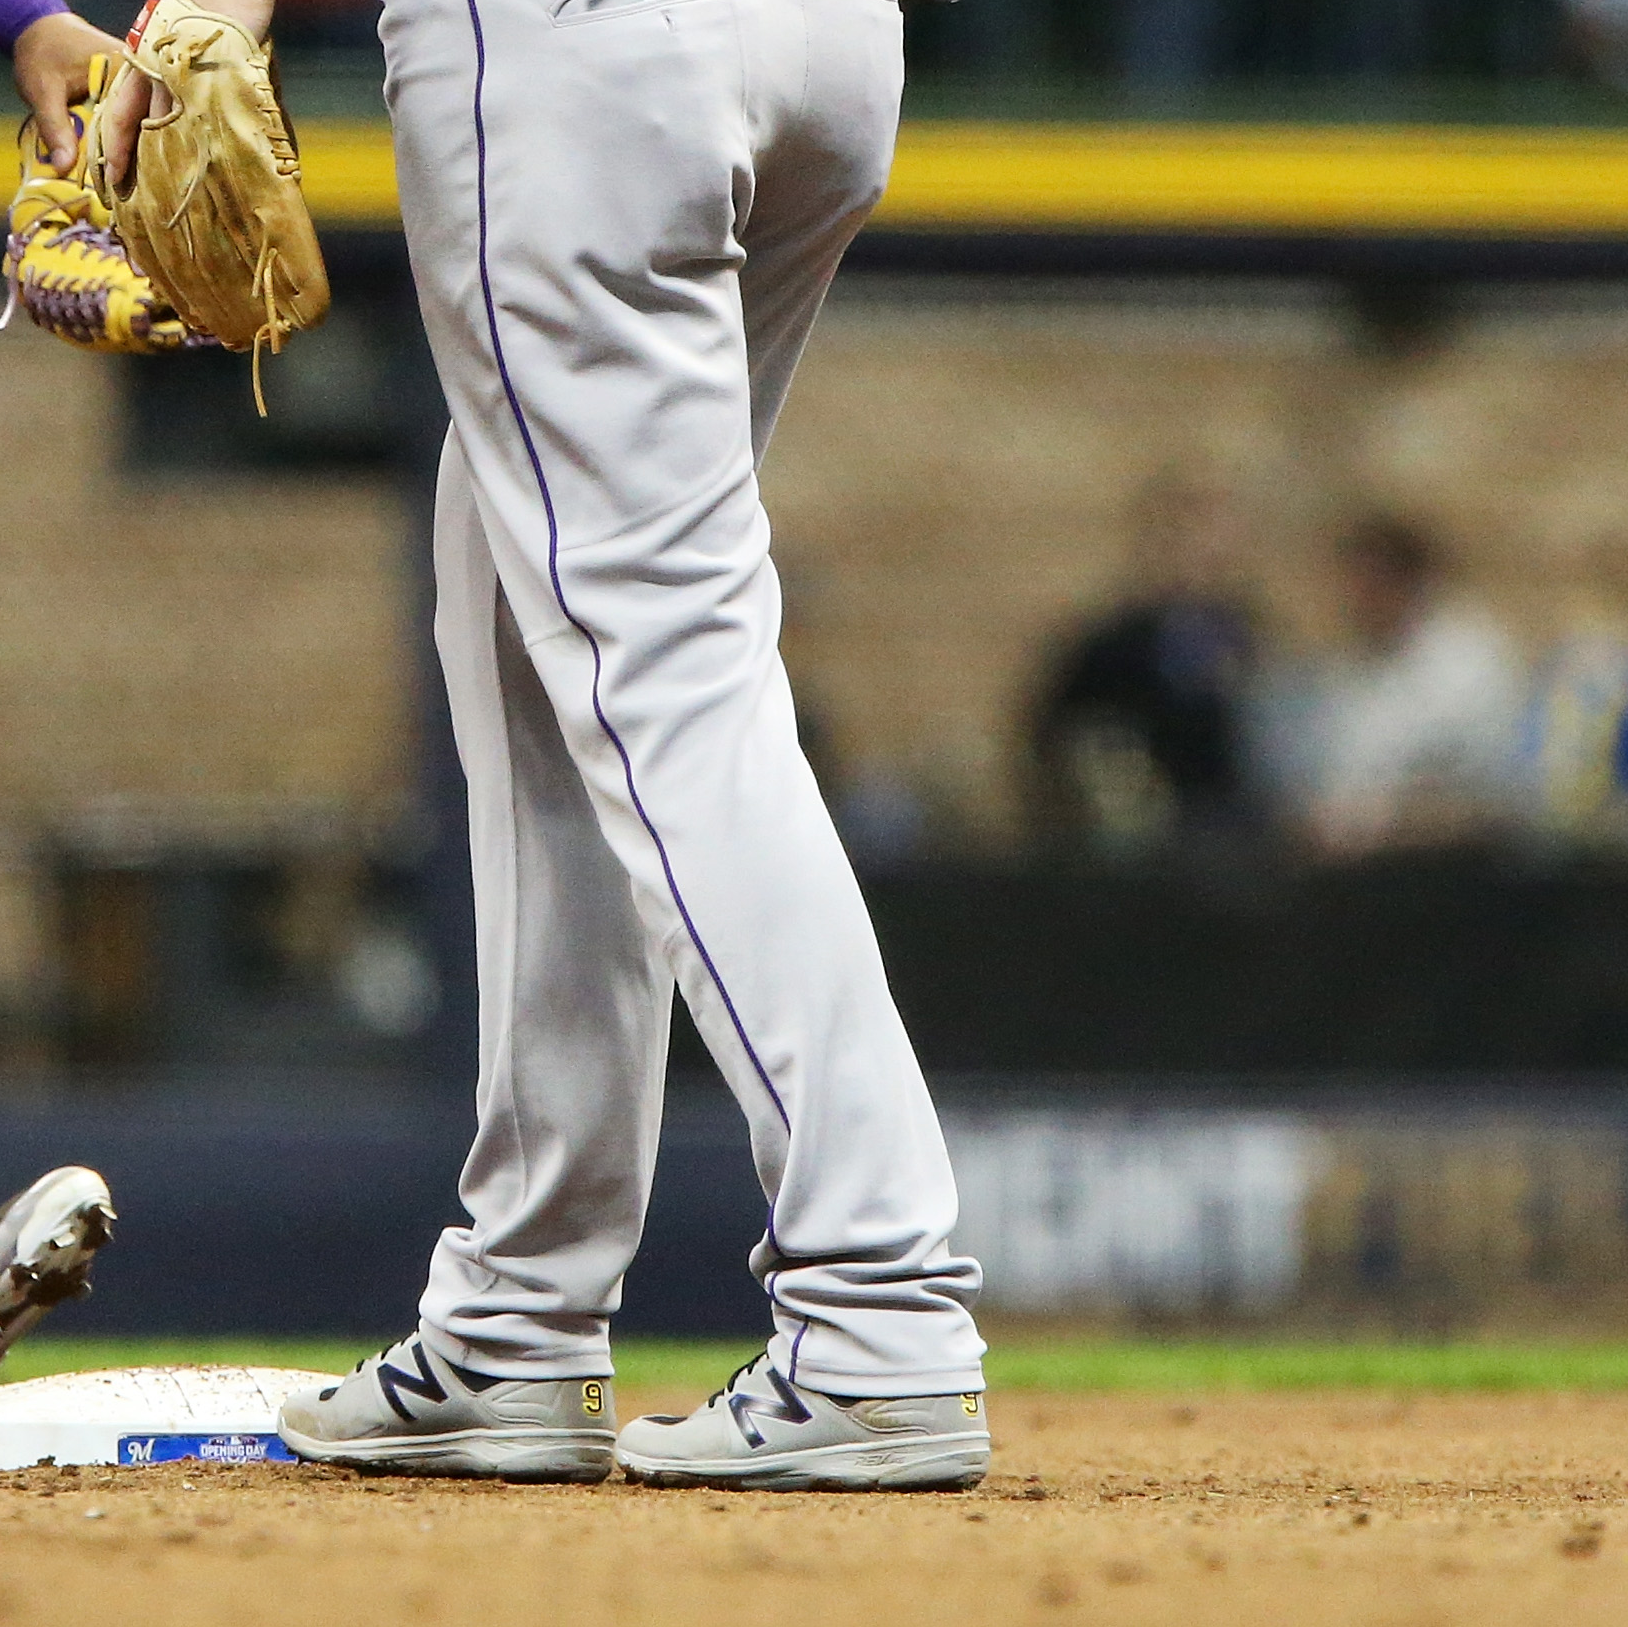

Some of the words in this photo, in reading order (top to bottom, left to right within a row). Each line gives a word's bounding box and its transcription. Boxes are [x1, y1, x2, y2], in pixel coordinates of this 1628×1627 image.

[581, 1379, 604, 1416] 9
[126, 1438, 156, 1463] M
[201, 1444, 245, 1457] OPENING
[246, 1444, 267, 1458] DAY
